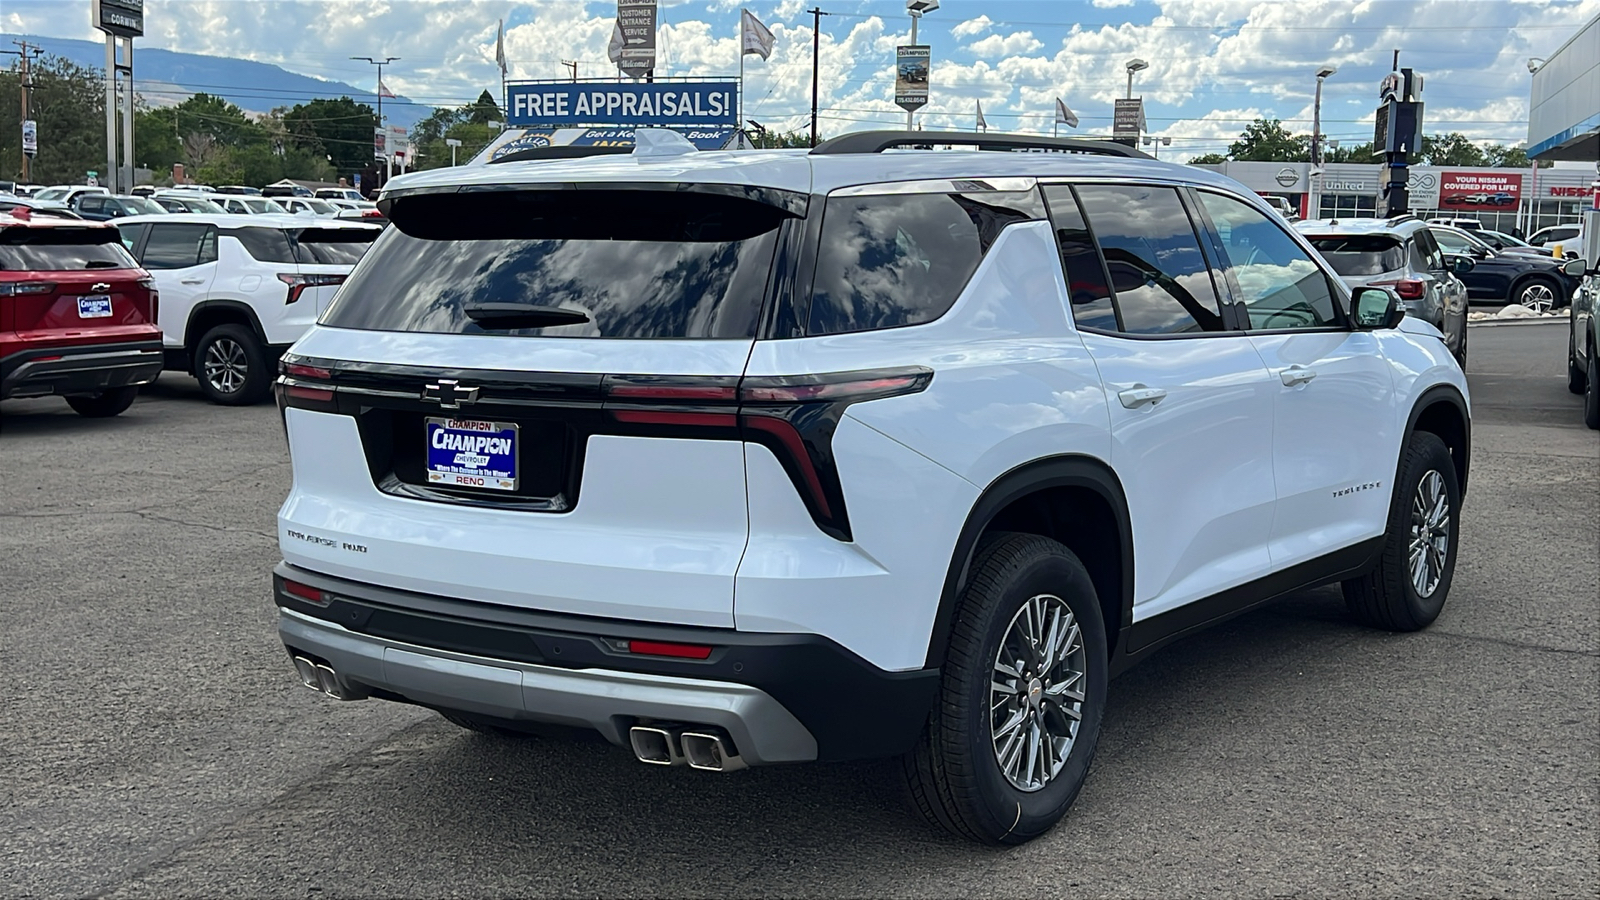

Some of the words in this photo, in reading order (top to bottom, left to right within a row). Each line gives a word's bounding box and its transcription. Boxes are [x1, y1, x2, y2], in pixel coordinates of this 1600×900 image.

[621, 9, 652, 17] CUSTOMER
[111, 13, 137, 28] CORWIN
[621, 18, 651, 26] ENTRANCE
[624, 28, 648, 36] SERVICE
[514, 93, 569, 117] FREE
[574, 92, 730, 117] APPRAISALS!
[586, 130, 606, 138] Get
[1455, 176, 1477, 184] YOUR
[1478, 176, 1507, 184] NISSAN
[1325, 181, 1364, 190] United
[448, 420, 492, 431] CHAMPION
[432, 428, 511, 455] CHAMPION
[456, 454, 487, 464] CHEVROLET
[451, 465, 459, 473] The
[456, 476, 485, 486] RENO
